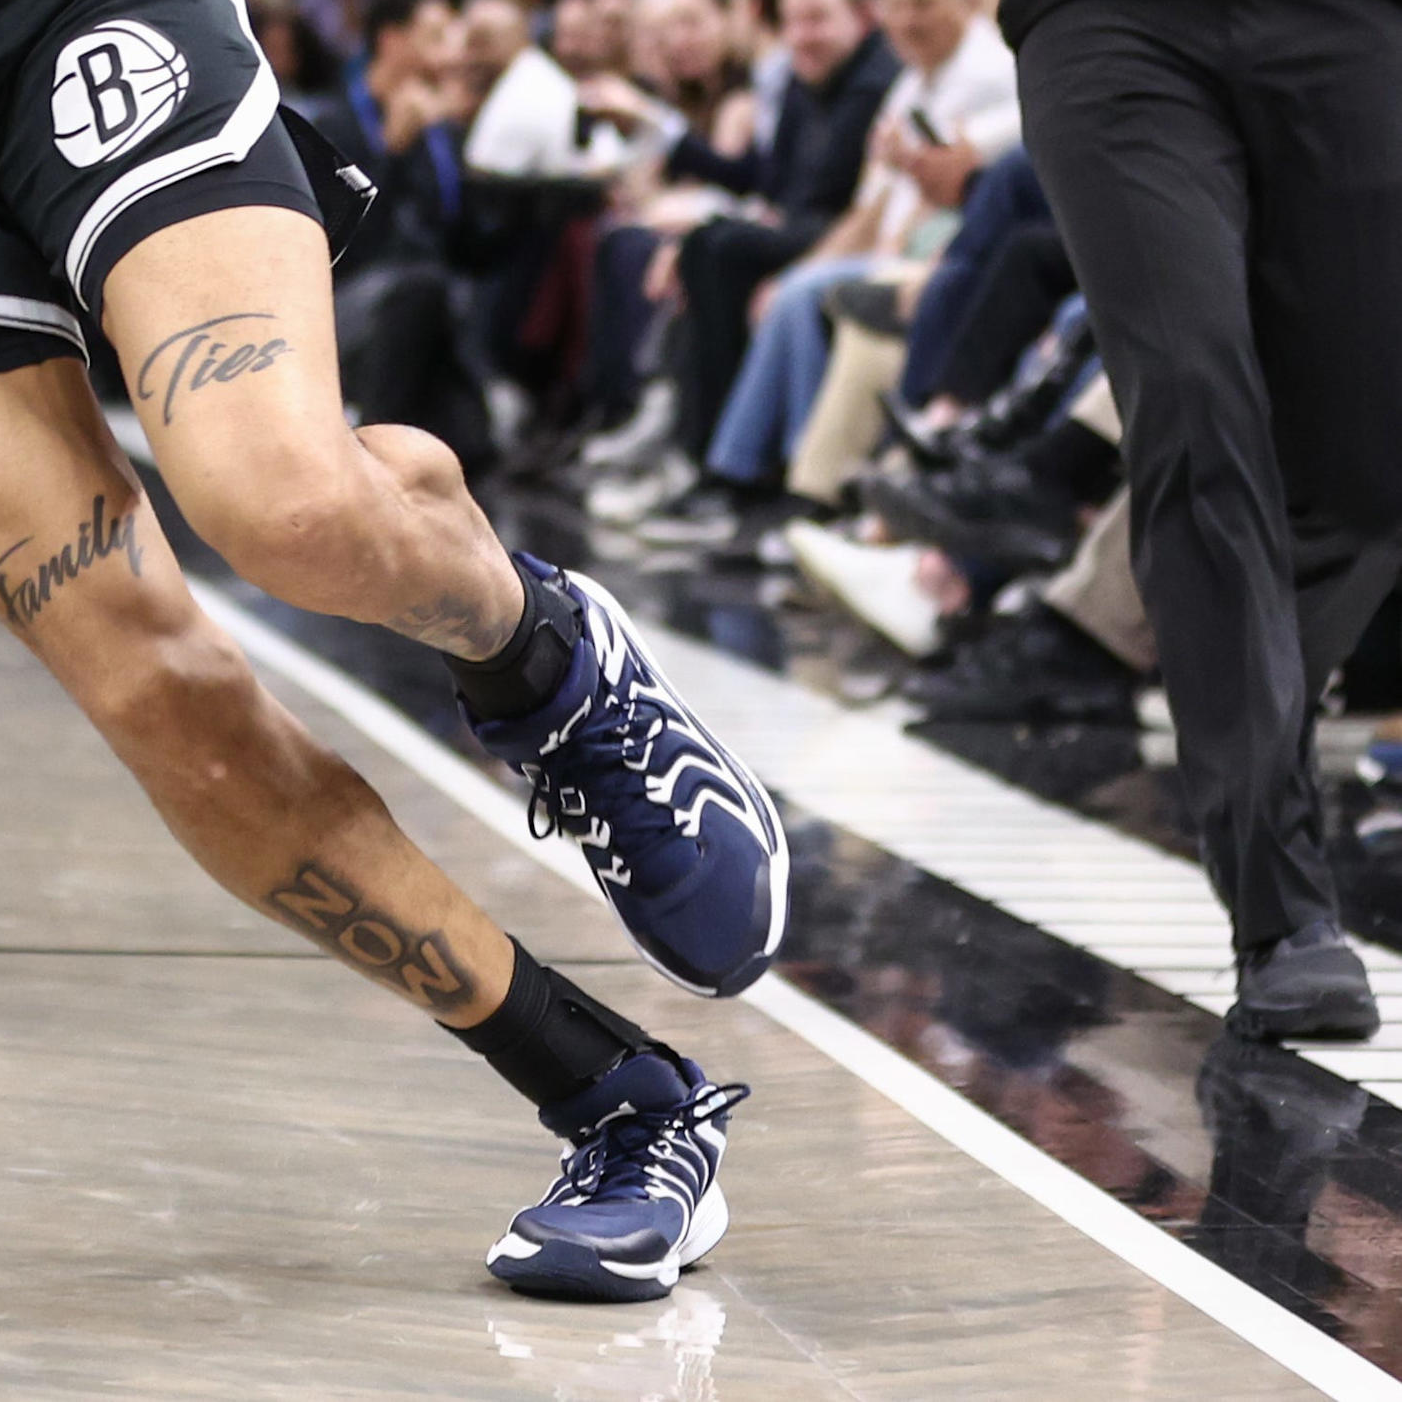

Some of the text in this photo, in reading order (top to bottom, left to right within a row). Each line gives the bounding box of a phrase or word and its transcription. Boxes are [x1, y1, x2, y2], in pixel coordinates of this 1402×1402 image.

[77, 42, 138, 145] B
[138, 312, 294, 426] Ties
[271, 866, 468, 1007] NOW
